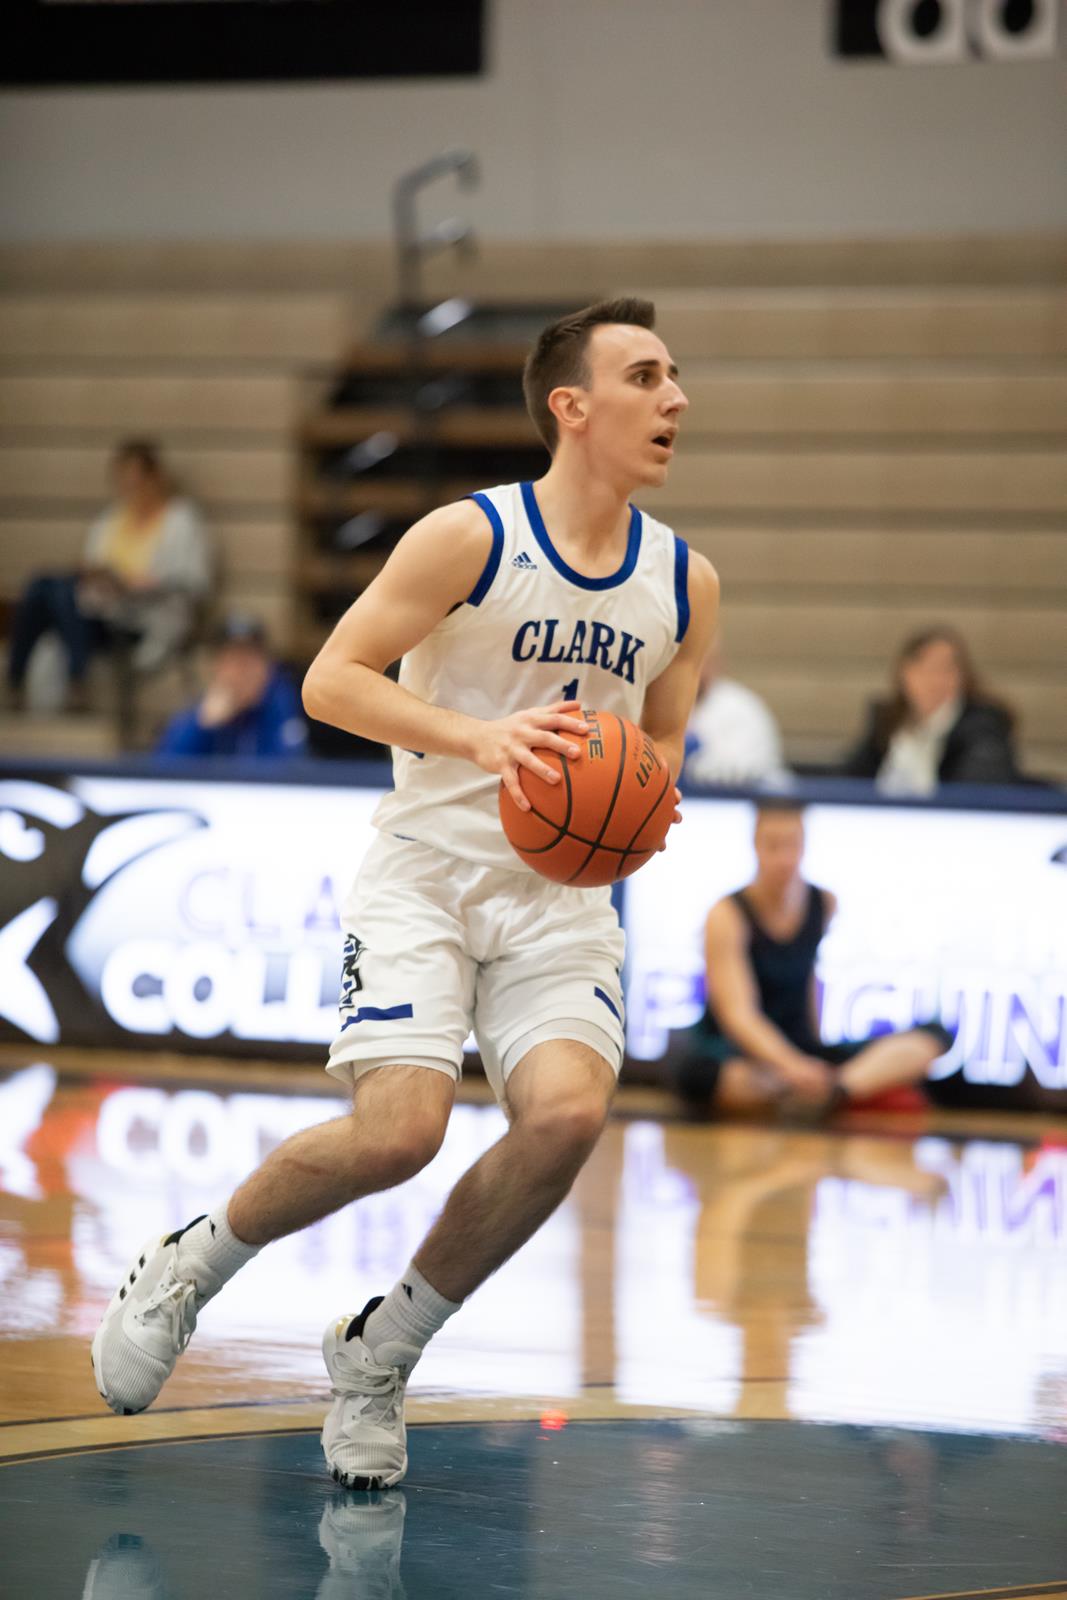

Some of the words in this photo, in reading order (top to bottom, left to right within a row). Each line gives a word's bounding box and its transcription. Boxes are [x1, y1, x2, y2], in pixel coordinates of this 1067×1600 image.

[512, 619, 645, 685] CLARK
[177, 865, 344, 938] CLA
[102, 940, 346, 1042] COLL
